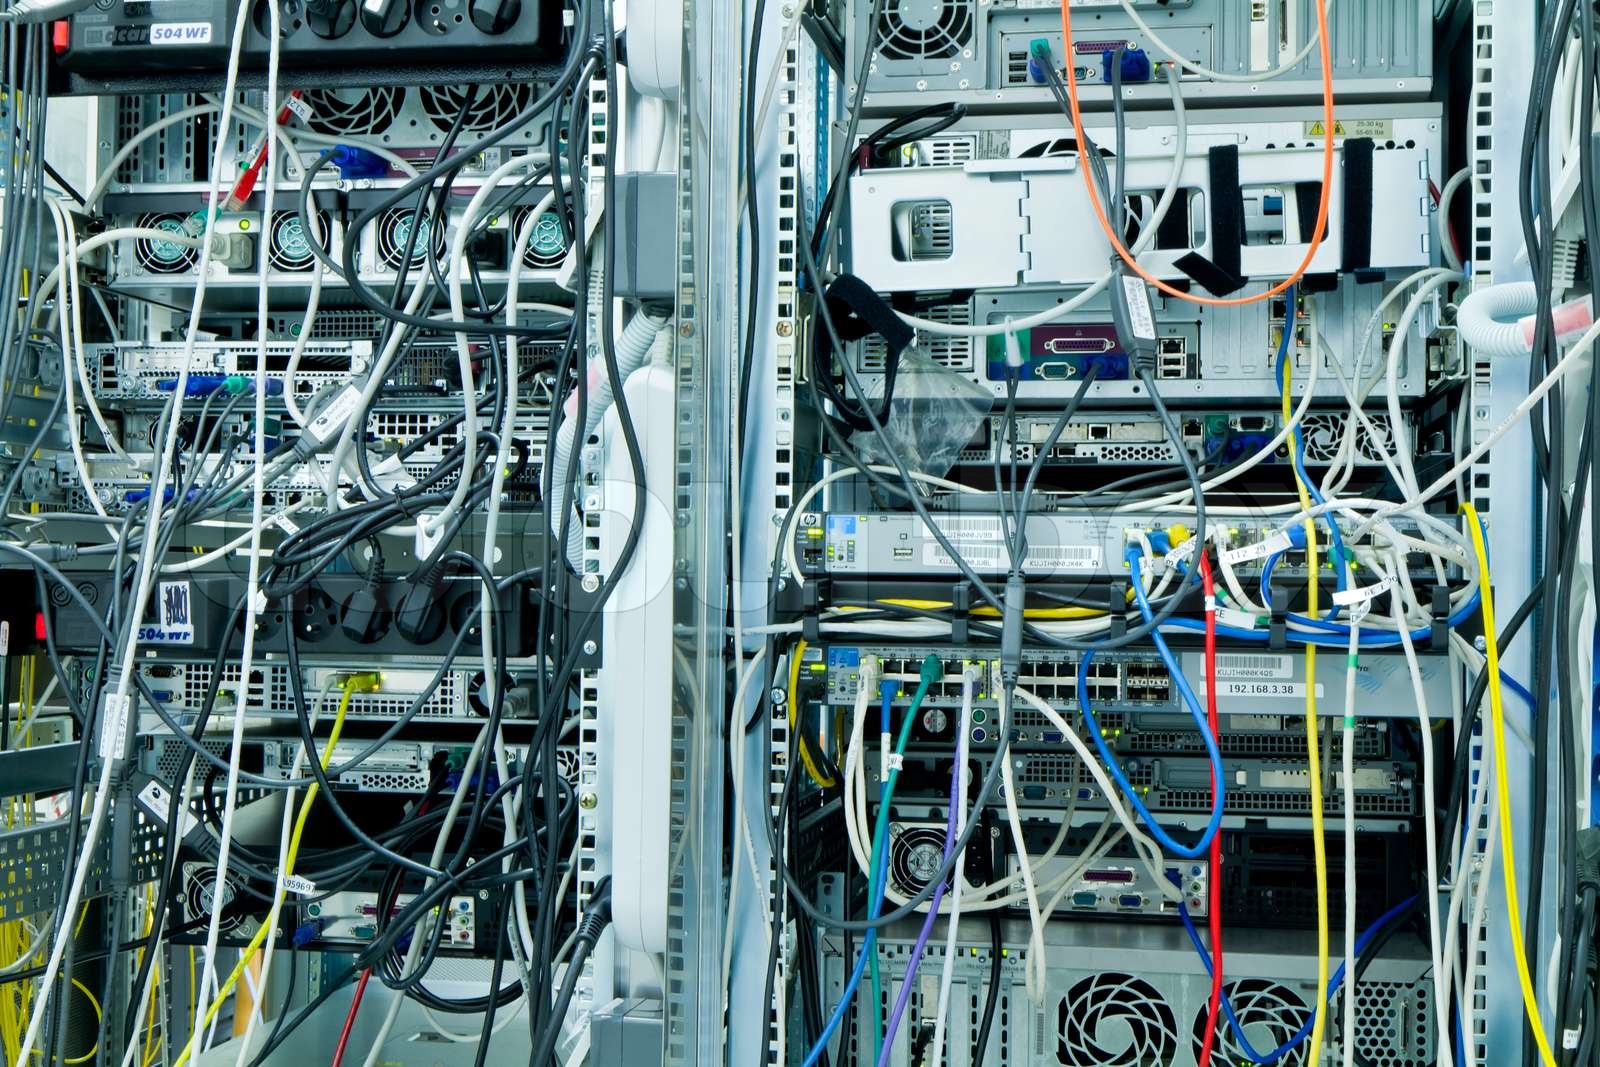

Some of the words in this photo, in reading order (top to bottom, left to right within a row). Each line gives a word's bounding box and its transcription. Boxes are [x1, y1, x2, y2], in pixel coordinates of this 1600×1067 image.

[153, 27, 183, 39] 504
[185, 26, 210, 39] WF
[138, 628, 166, 640] 504
[1229, 684, 1295, 694] 192.168.3.38
